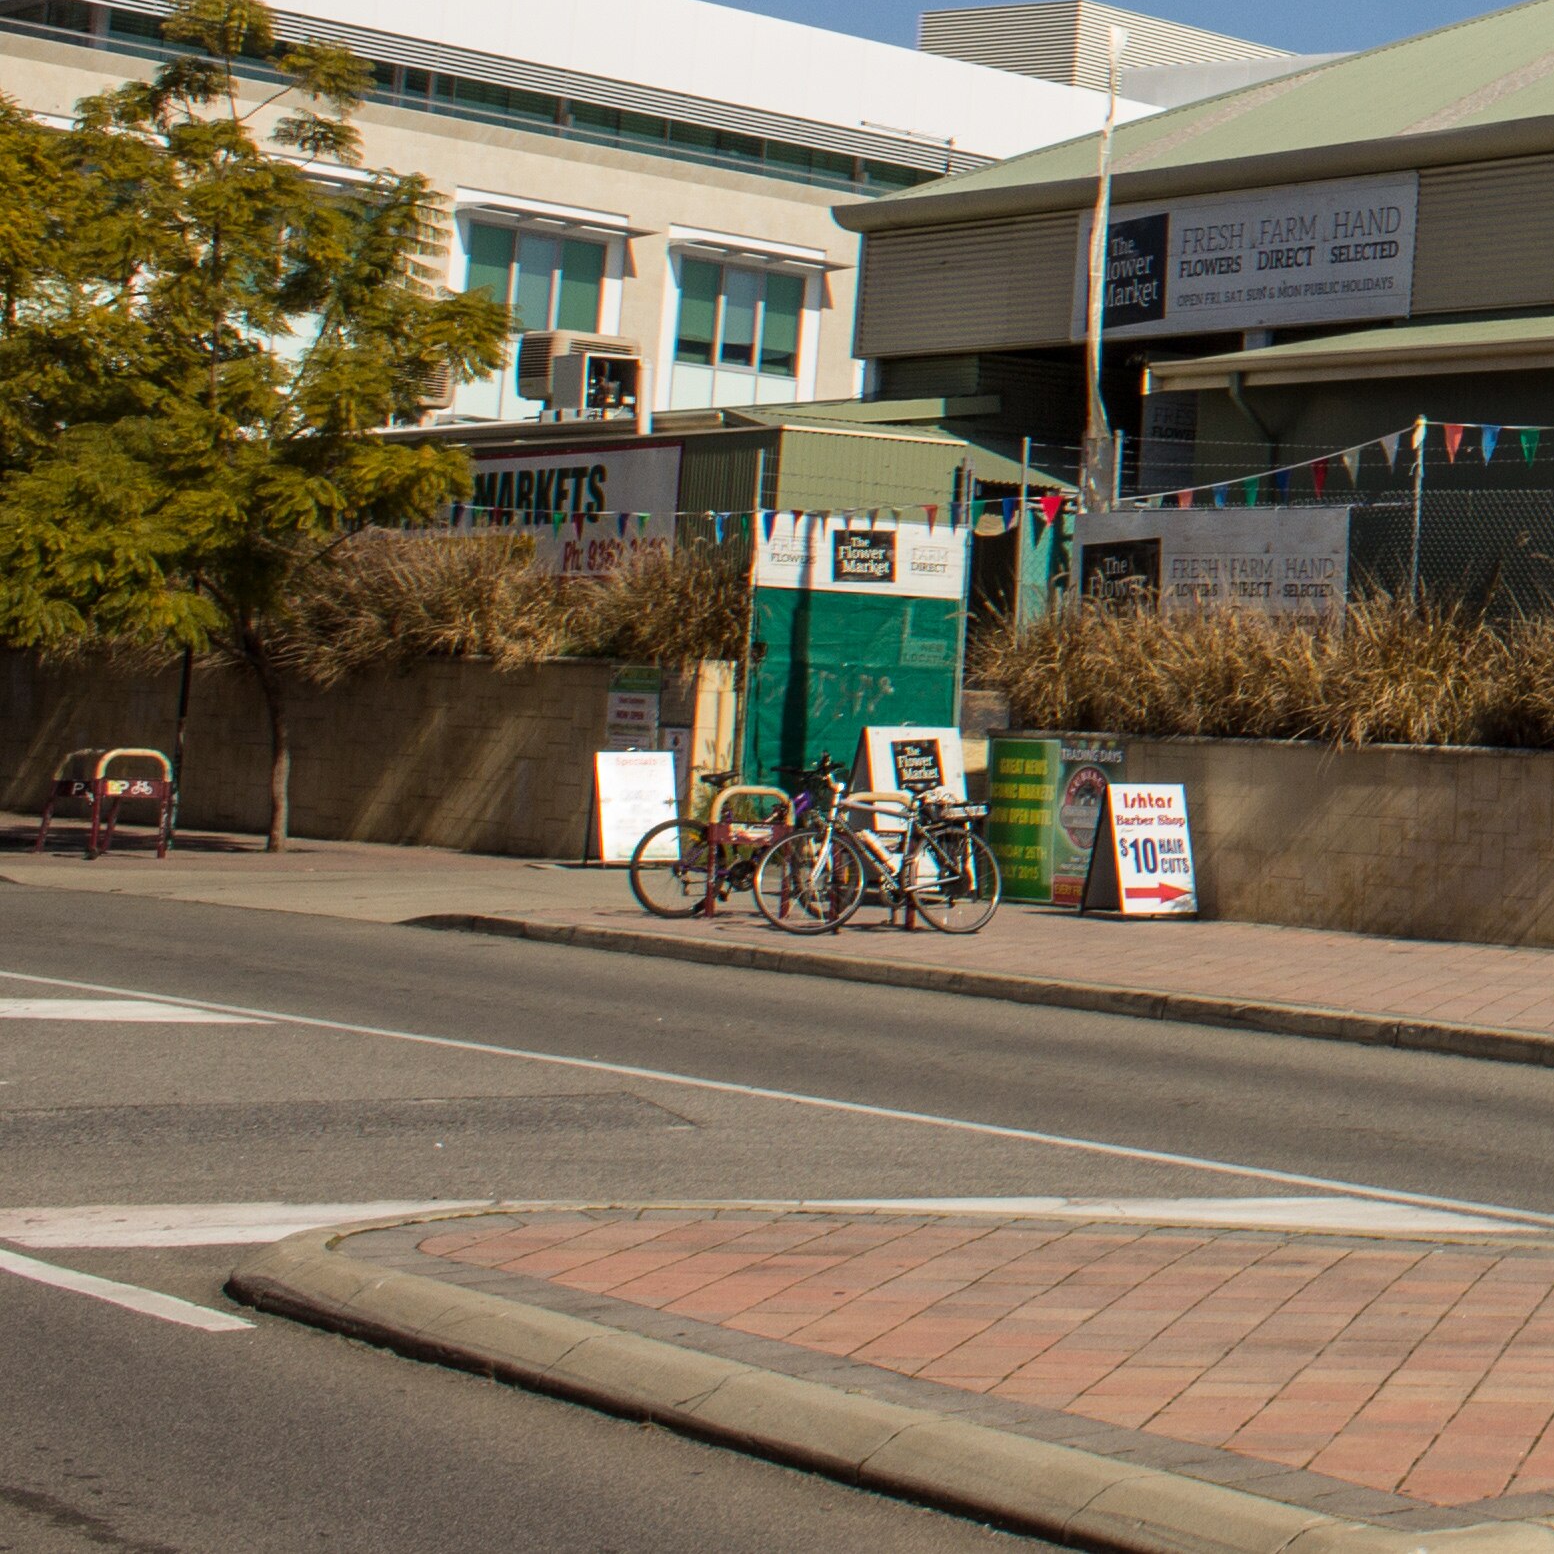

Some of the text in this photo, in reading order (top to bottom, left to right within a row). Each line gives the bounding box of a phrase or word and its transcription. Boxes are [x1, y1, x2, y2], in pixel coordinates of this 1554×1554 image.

[1181, 206, 1401, 254] FRESH FARM HAND
[1112, 237, 1135, 255] The
[1179, 240, 1399, 278] FLOWERS DIRECT SELECTED
[1105, 255, 1154, 282] lower
[1176, 292, 1204, 307] OPEN
[1246, 286, 1267, 301] SUN
[1303, 280, 1341, 296] PUBLIC
[1341, 276, 1394, 294] HOLIDAYS
[472, 464, 608, 527] MARKETS
[850, 536, 870, 547] The
[838, 546, 886, 560] Flower
[841, 559, 890, 576] Market
[911, 562, 948, 574] DIRECT
[1103, 555, 1128, 574] The
[1171, 558, 1335, 579] FRESH FARM HAND
[897, 756, 934, 768] Flower
[1061, 747, 1124, 763] TRADING DAYS
[902, 767, 939, 779] Market
[1123, 792, 1173, 809] Ishtar
[1116, 814, 1185, 828] Barber Shop
[1158, 838, 1185, 854] HAIR
[1119, 837, 1158, 874] $10
[1160, 858, 1190, 874] CUTS
